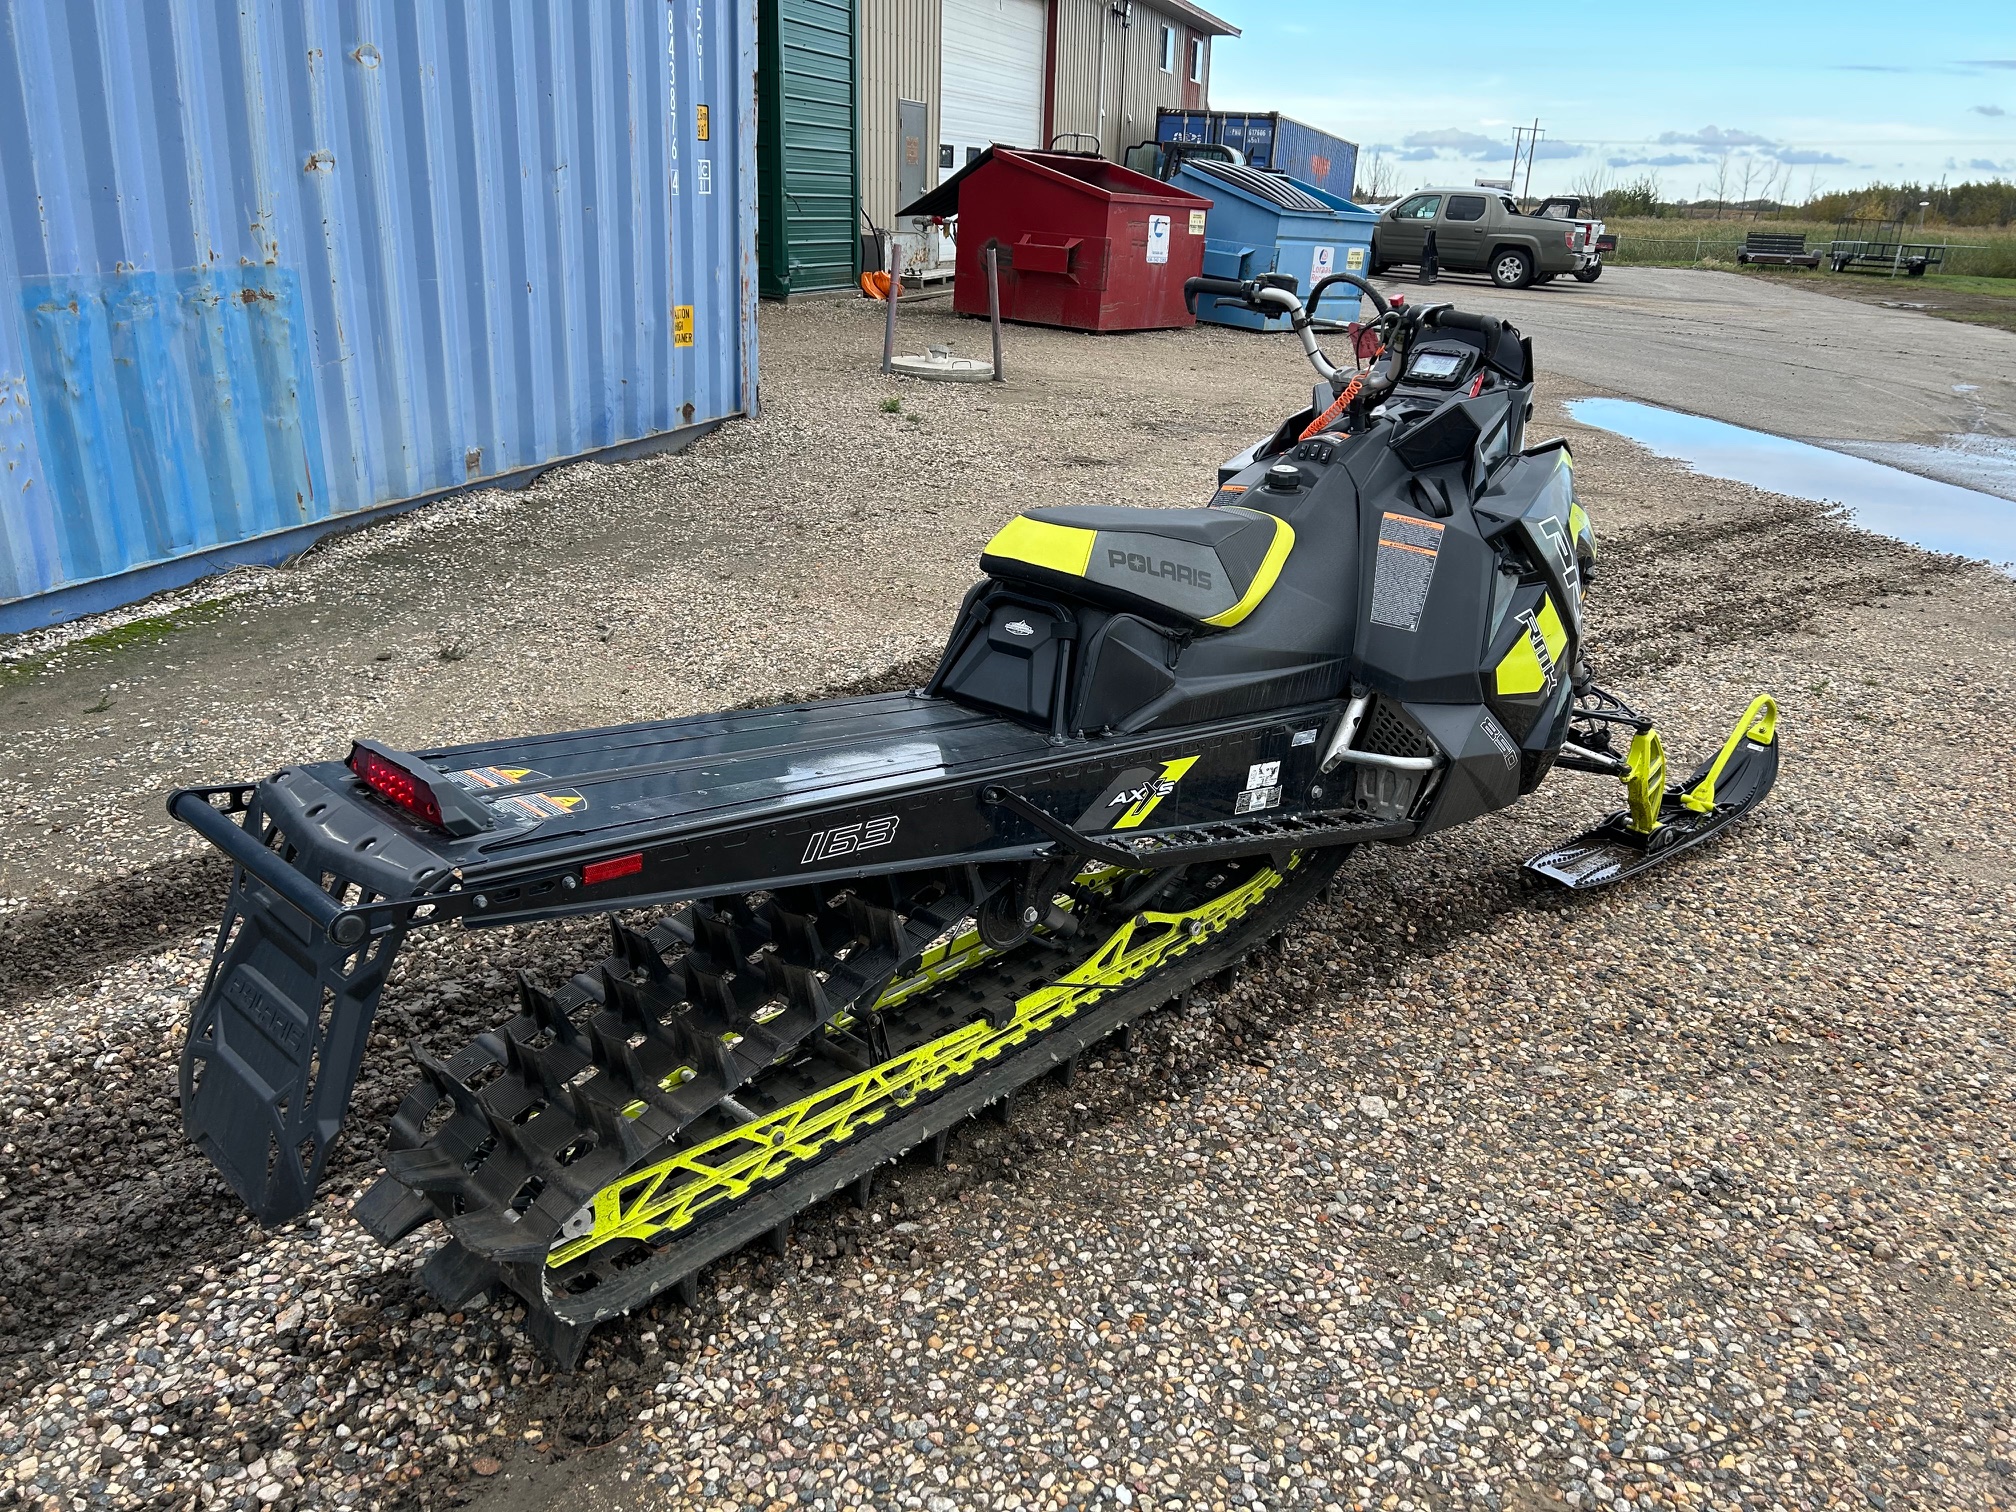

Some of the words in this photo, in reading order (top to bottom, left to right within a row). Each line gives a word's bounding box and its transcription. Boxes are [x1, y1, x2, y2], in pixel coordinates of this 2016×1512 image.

[672, 171, 679, 194] 4
[1107, 549, 1213, 591] POLARIS
[1514, 607, 1558, 698] RMK
[1480, 716, 1519, 771] 850
[1106, 778, 1176, 815] AXYS
[800, 815, 901, 865] 163
[229, 977, 306, 1054] POLARIS
